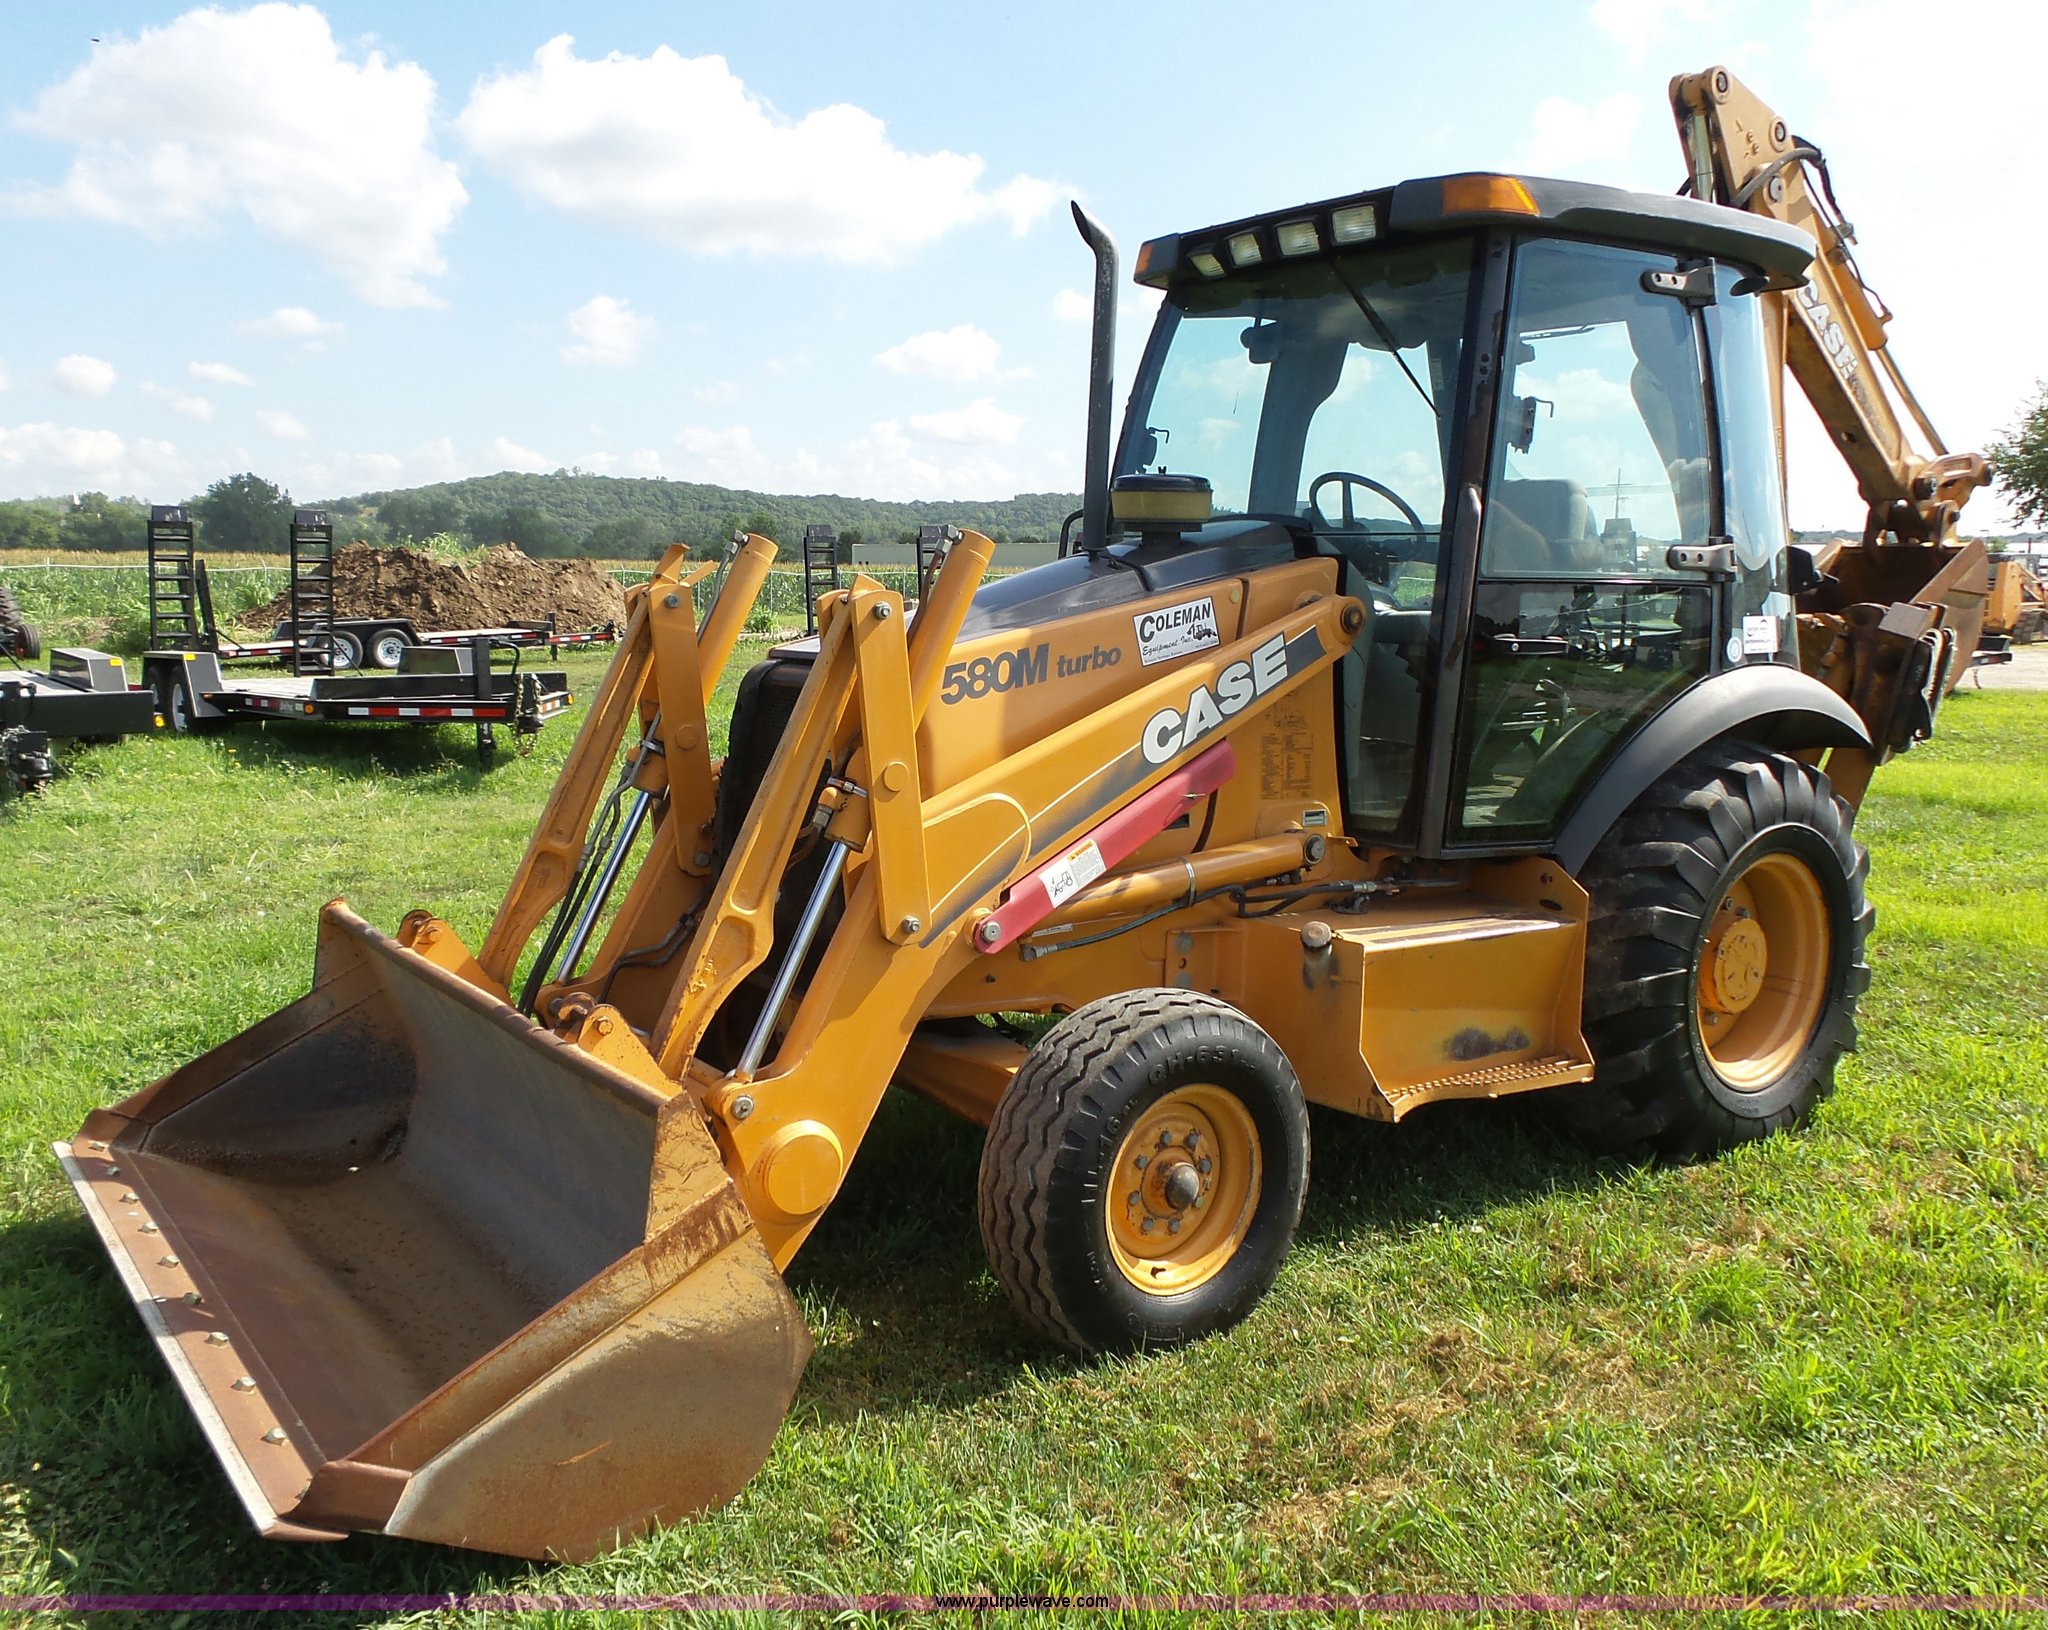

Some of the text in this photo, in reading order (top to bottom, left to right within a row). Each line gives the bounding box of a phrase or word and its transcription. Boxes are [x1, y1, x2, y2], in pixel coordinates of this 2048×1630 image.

[1140, 602, 1211, 643] COLEMAN
[1142, 640, 1179, 656] Equipment
[940, 643, 1122, 705] 580M turbo
[1141, 632, 1289, 764] CASE
